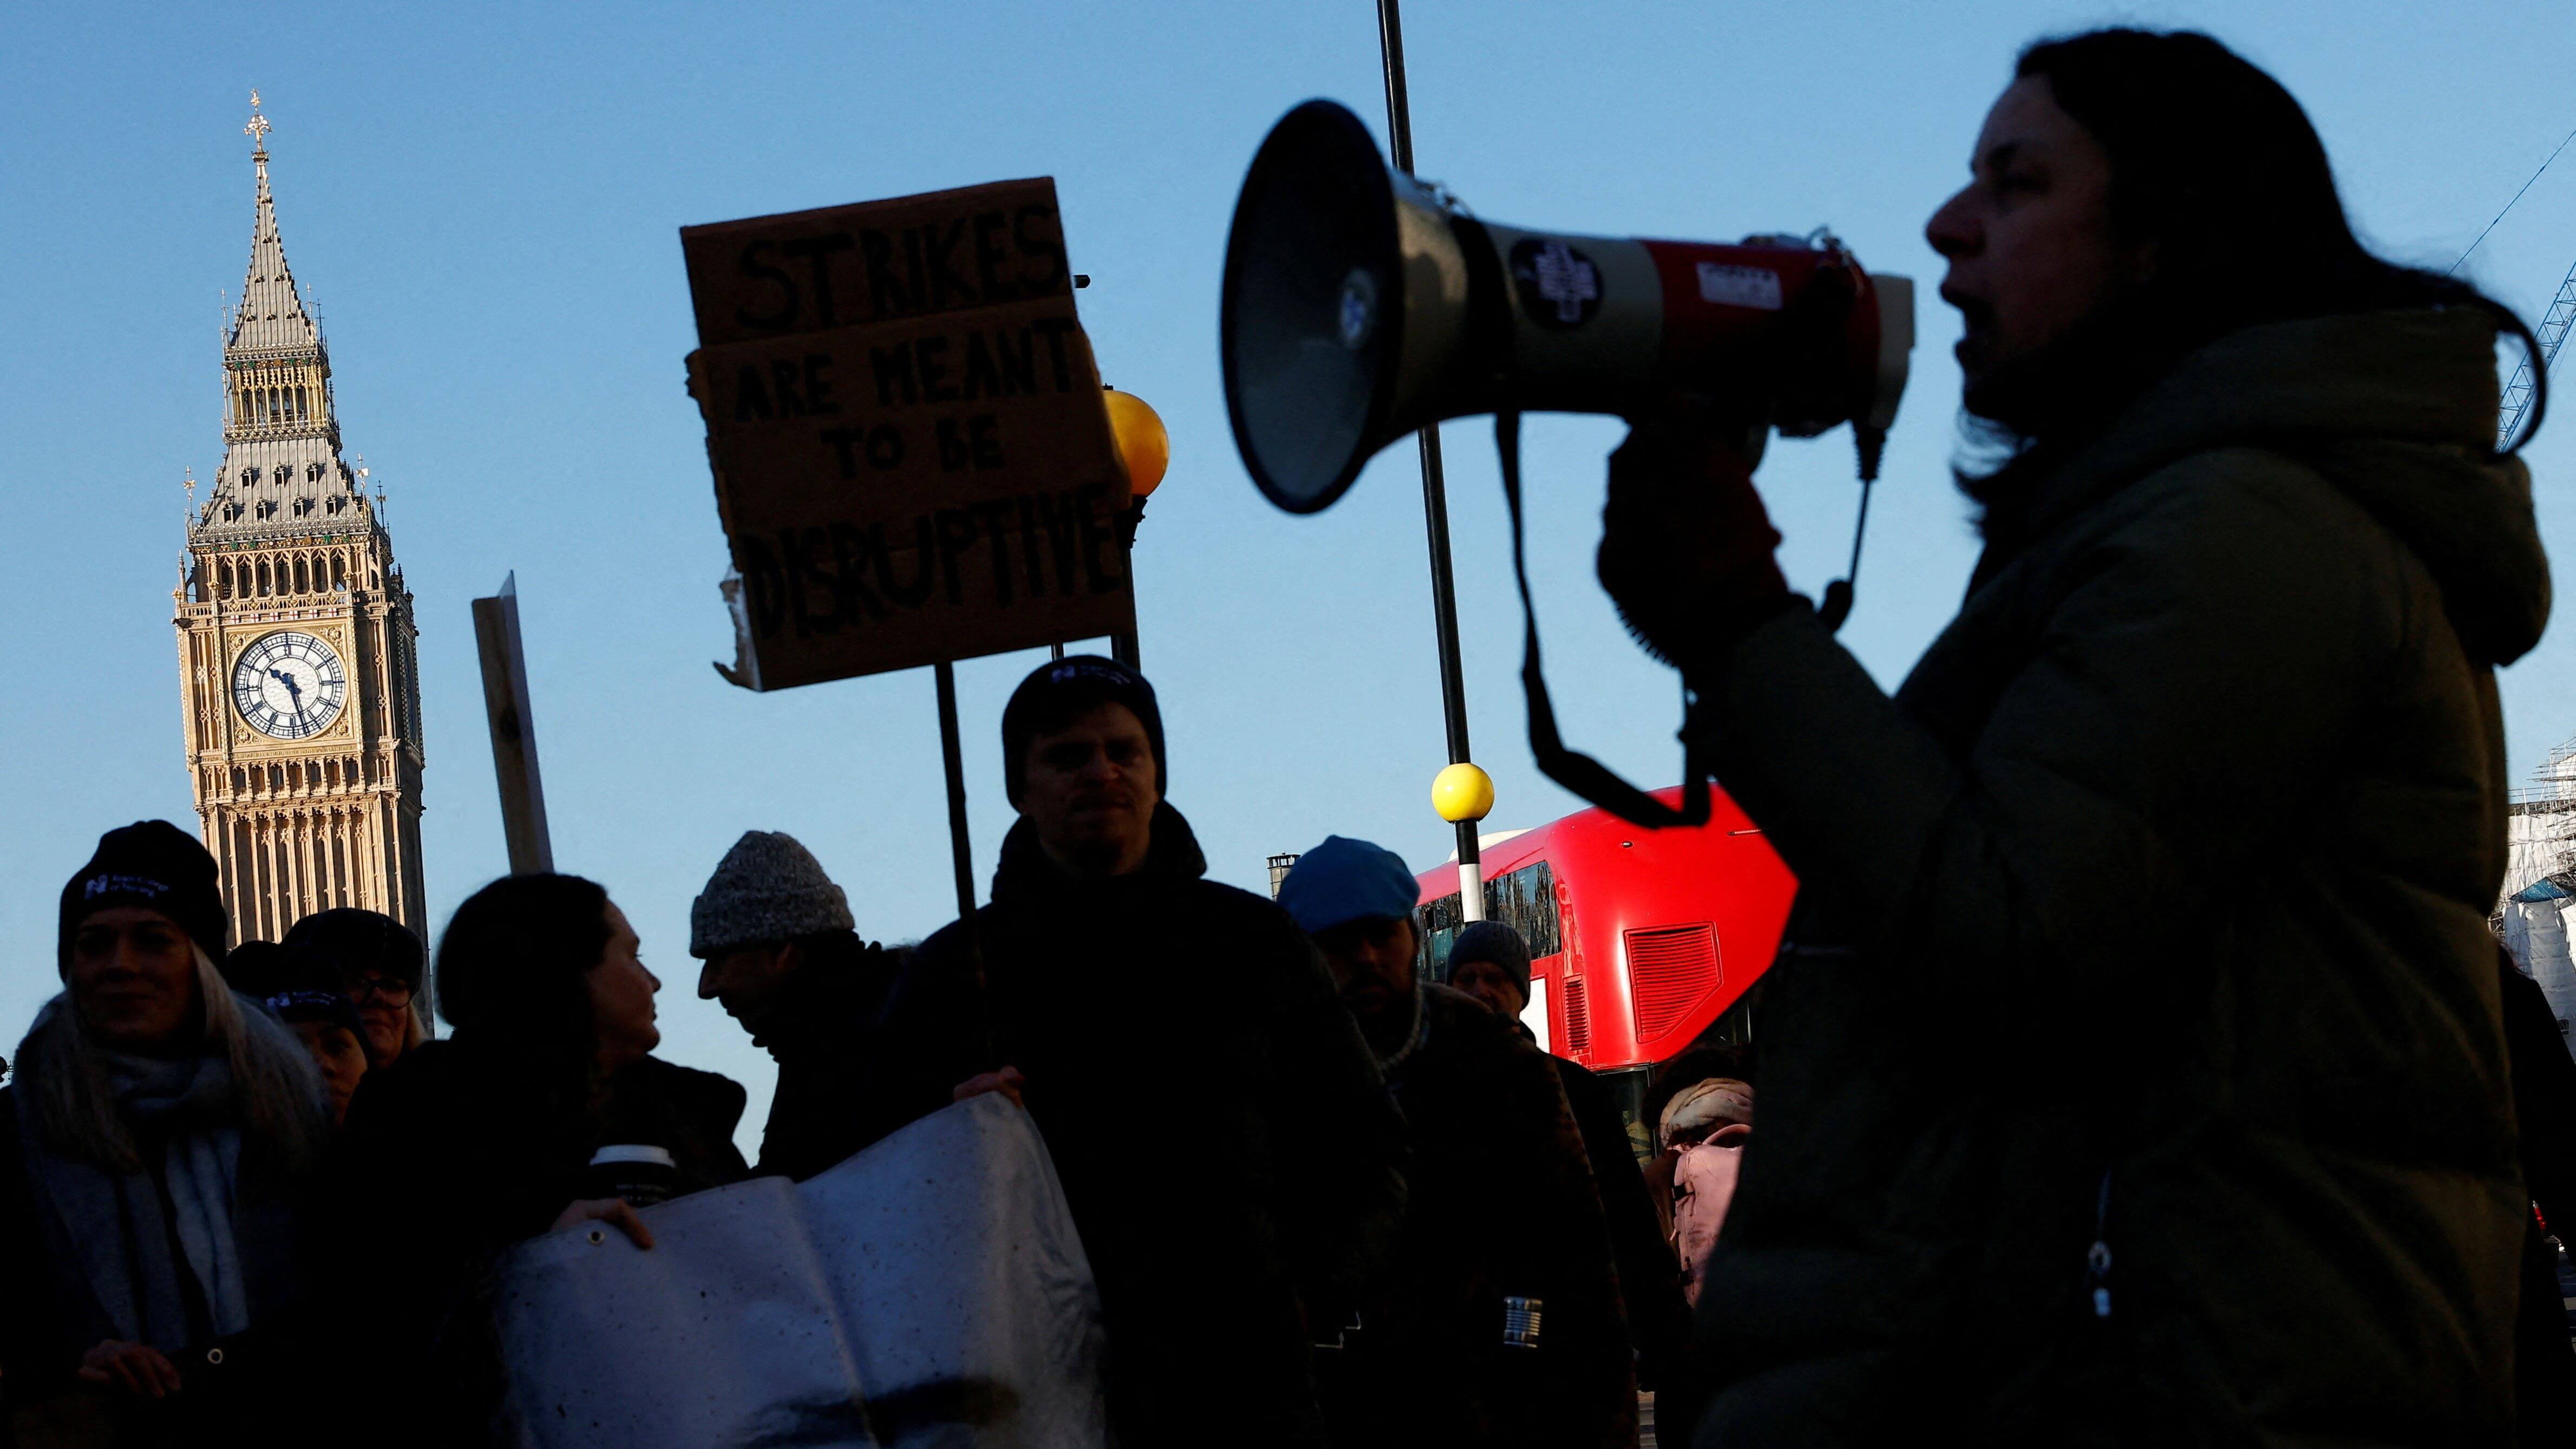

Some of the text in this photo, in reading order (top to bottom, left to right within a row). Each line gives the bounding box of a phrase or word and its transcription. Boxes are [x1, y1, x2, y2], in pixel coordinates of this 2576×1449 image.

[737, 206, 1068, 330] STRIKES
[735, 319, 1075, 421] ARE MEANT
[820, 416, 1003, 479] TO BE
[740, 483, 1123, 637] DISRUPTIVE
